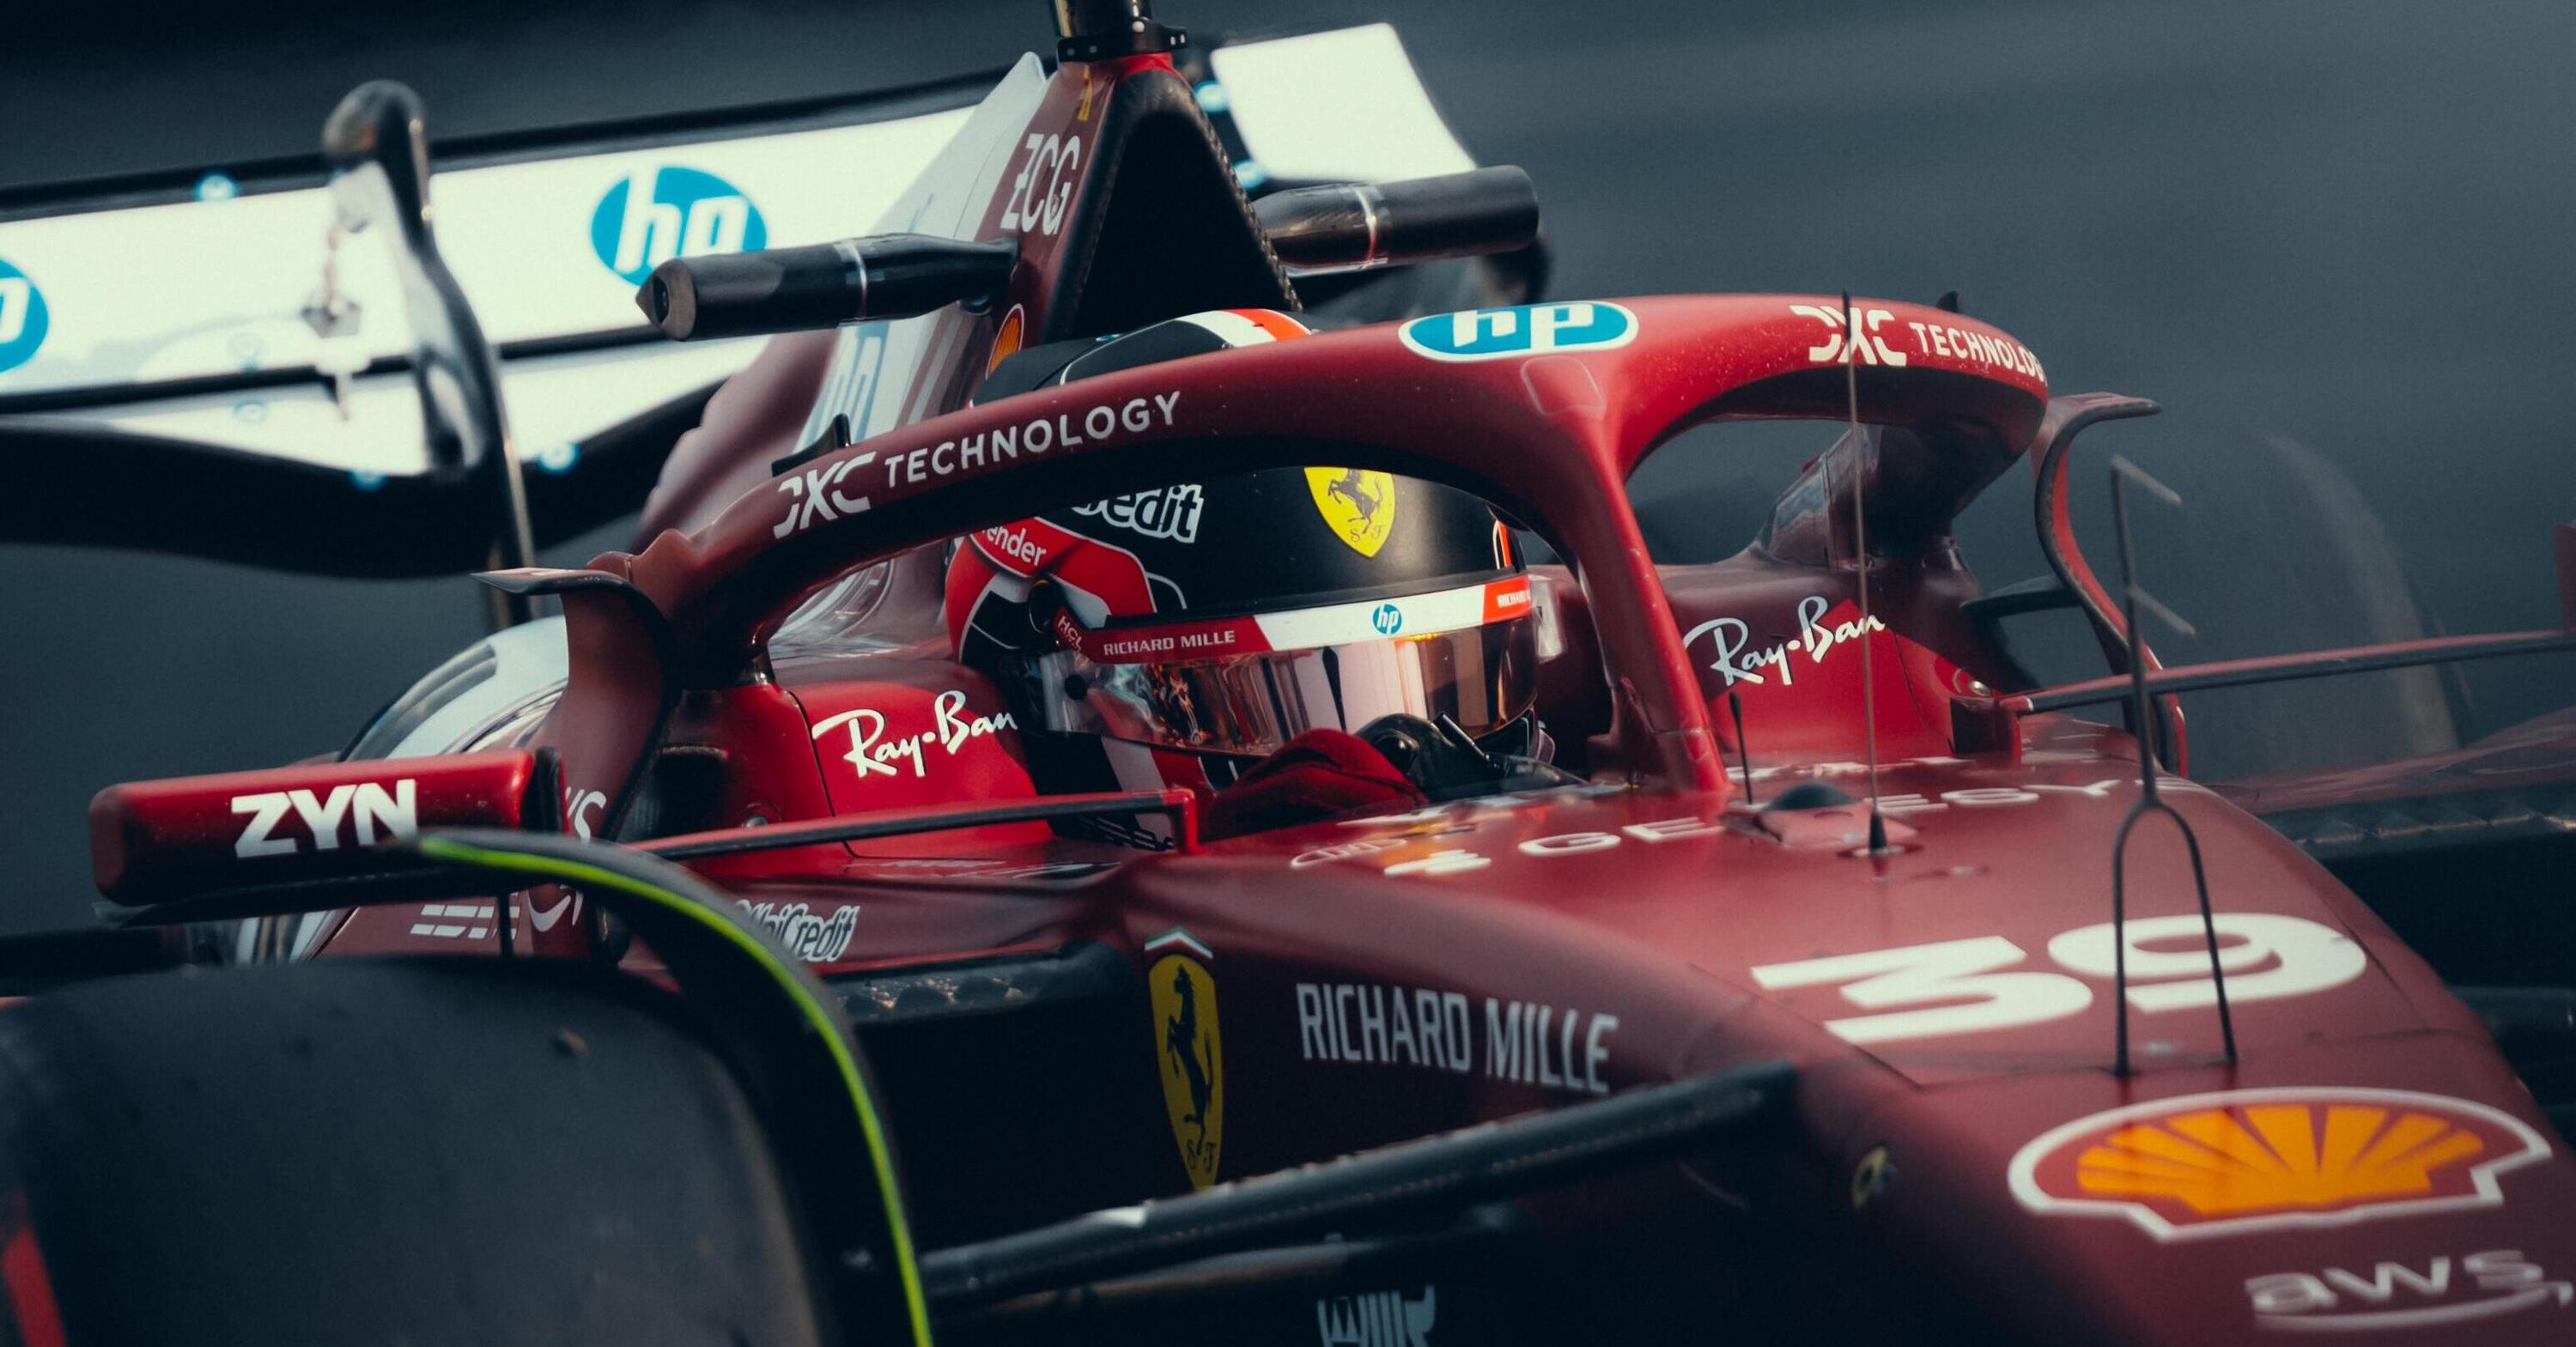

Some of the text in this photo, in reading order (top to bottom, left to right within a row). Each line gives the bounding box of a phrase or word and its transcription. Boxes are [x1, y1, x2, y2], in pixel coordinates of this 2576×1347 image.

[1451, 303, 1595, 353] hp
[884, 391, 1182, 488] TECHNOLOGY
[1103, 630, 1236, 656] RICHARD MILLE
[1376, 604, 1400, 635] hp
[230, 777, 418, 859] ZYN
[1750, 912, 2369, 1044] 39
[1296, 982, 1619, 1094] RICHARD MILLE
[2244, 1247, 2546, 1314] aws
